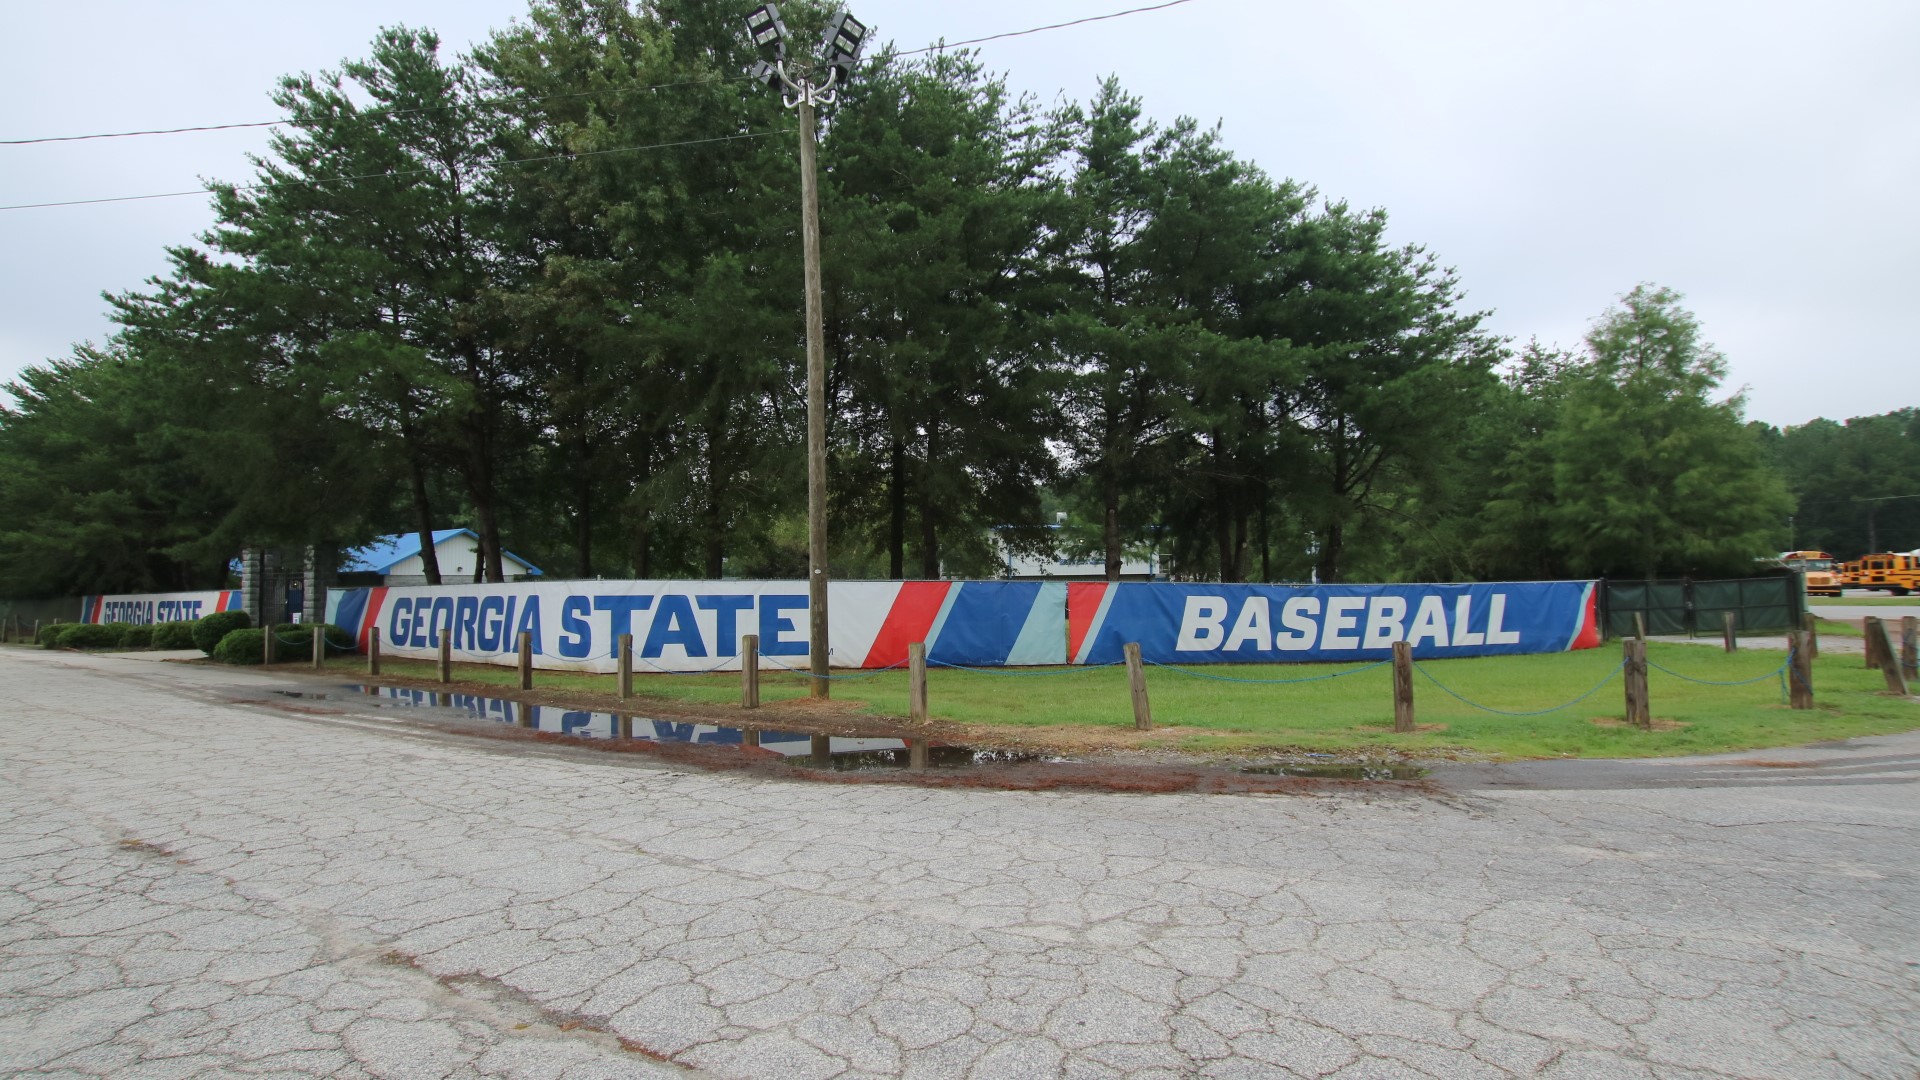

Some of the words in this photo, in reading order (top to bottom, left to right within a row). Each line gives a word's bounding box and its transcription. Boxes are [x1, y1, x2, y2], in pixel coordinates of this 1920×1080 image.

[104, 601, 154, 625] GEORGIA
[157, 600, 203, 624] STATE
[389, 594, 543, 655] GEORGIA
[558, 594, 810, 658] STATE
[1175, 593, 1520, 652] BASEBALL
